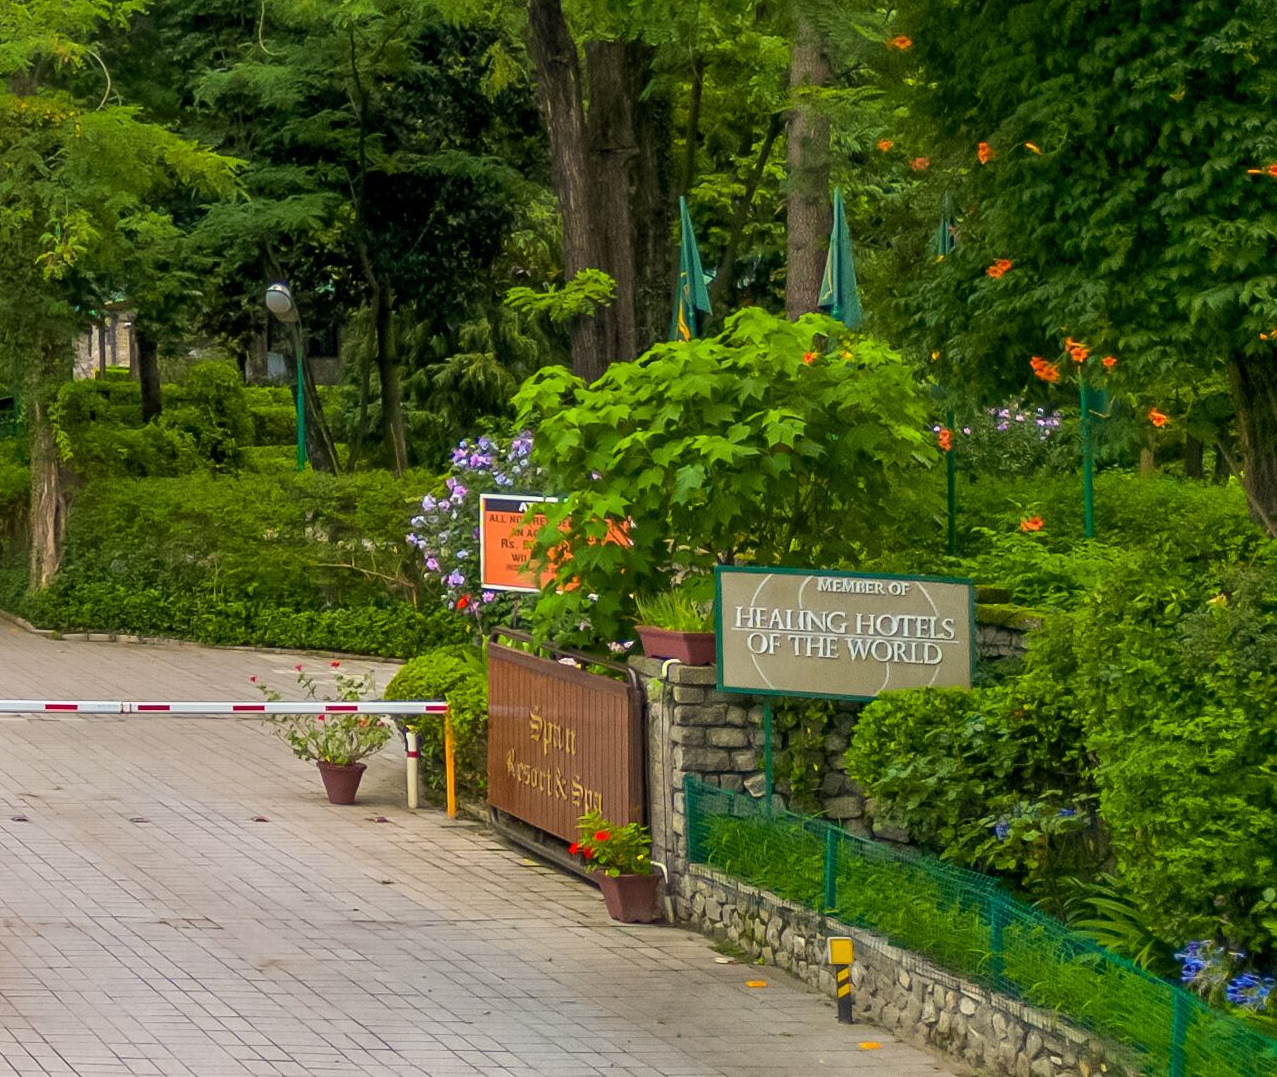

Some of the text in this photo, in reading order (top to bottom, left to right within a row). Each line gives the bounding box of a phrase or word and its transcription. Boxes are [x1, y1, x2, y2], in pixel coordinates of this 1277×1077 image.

[816, 576, 911, 596] MEMBER OF
[734, 606, 956, 640] HEALING HOTELS
[746, 632, 943, 666] OF THE WORLD
